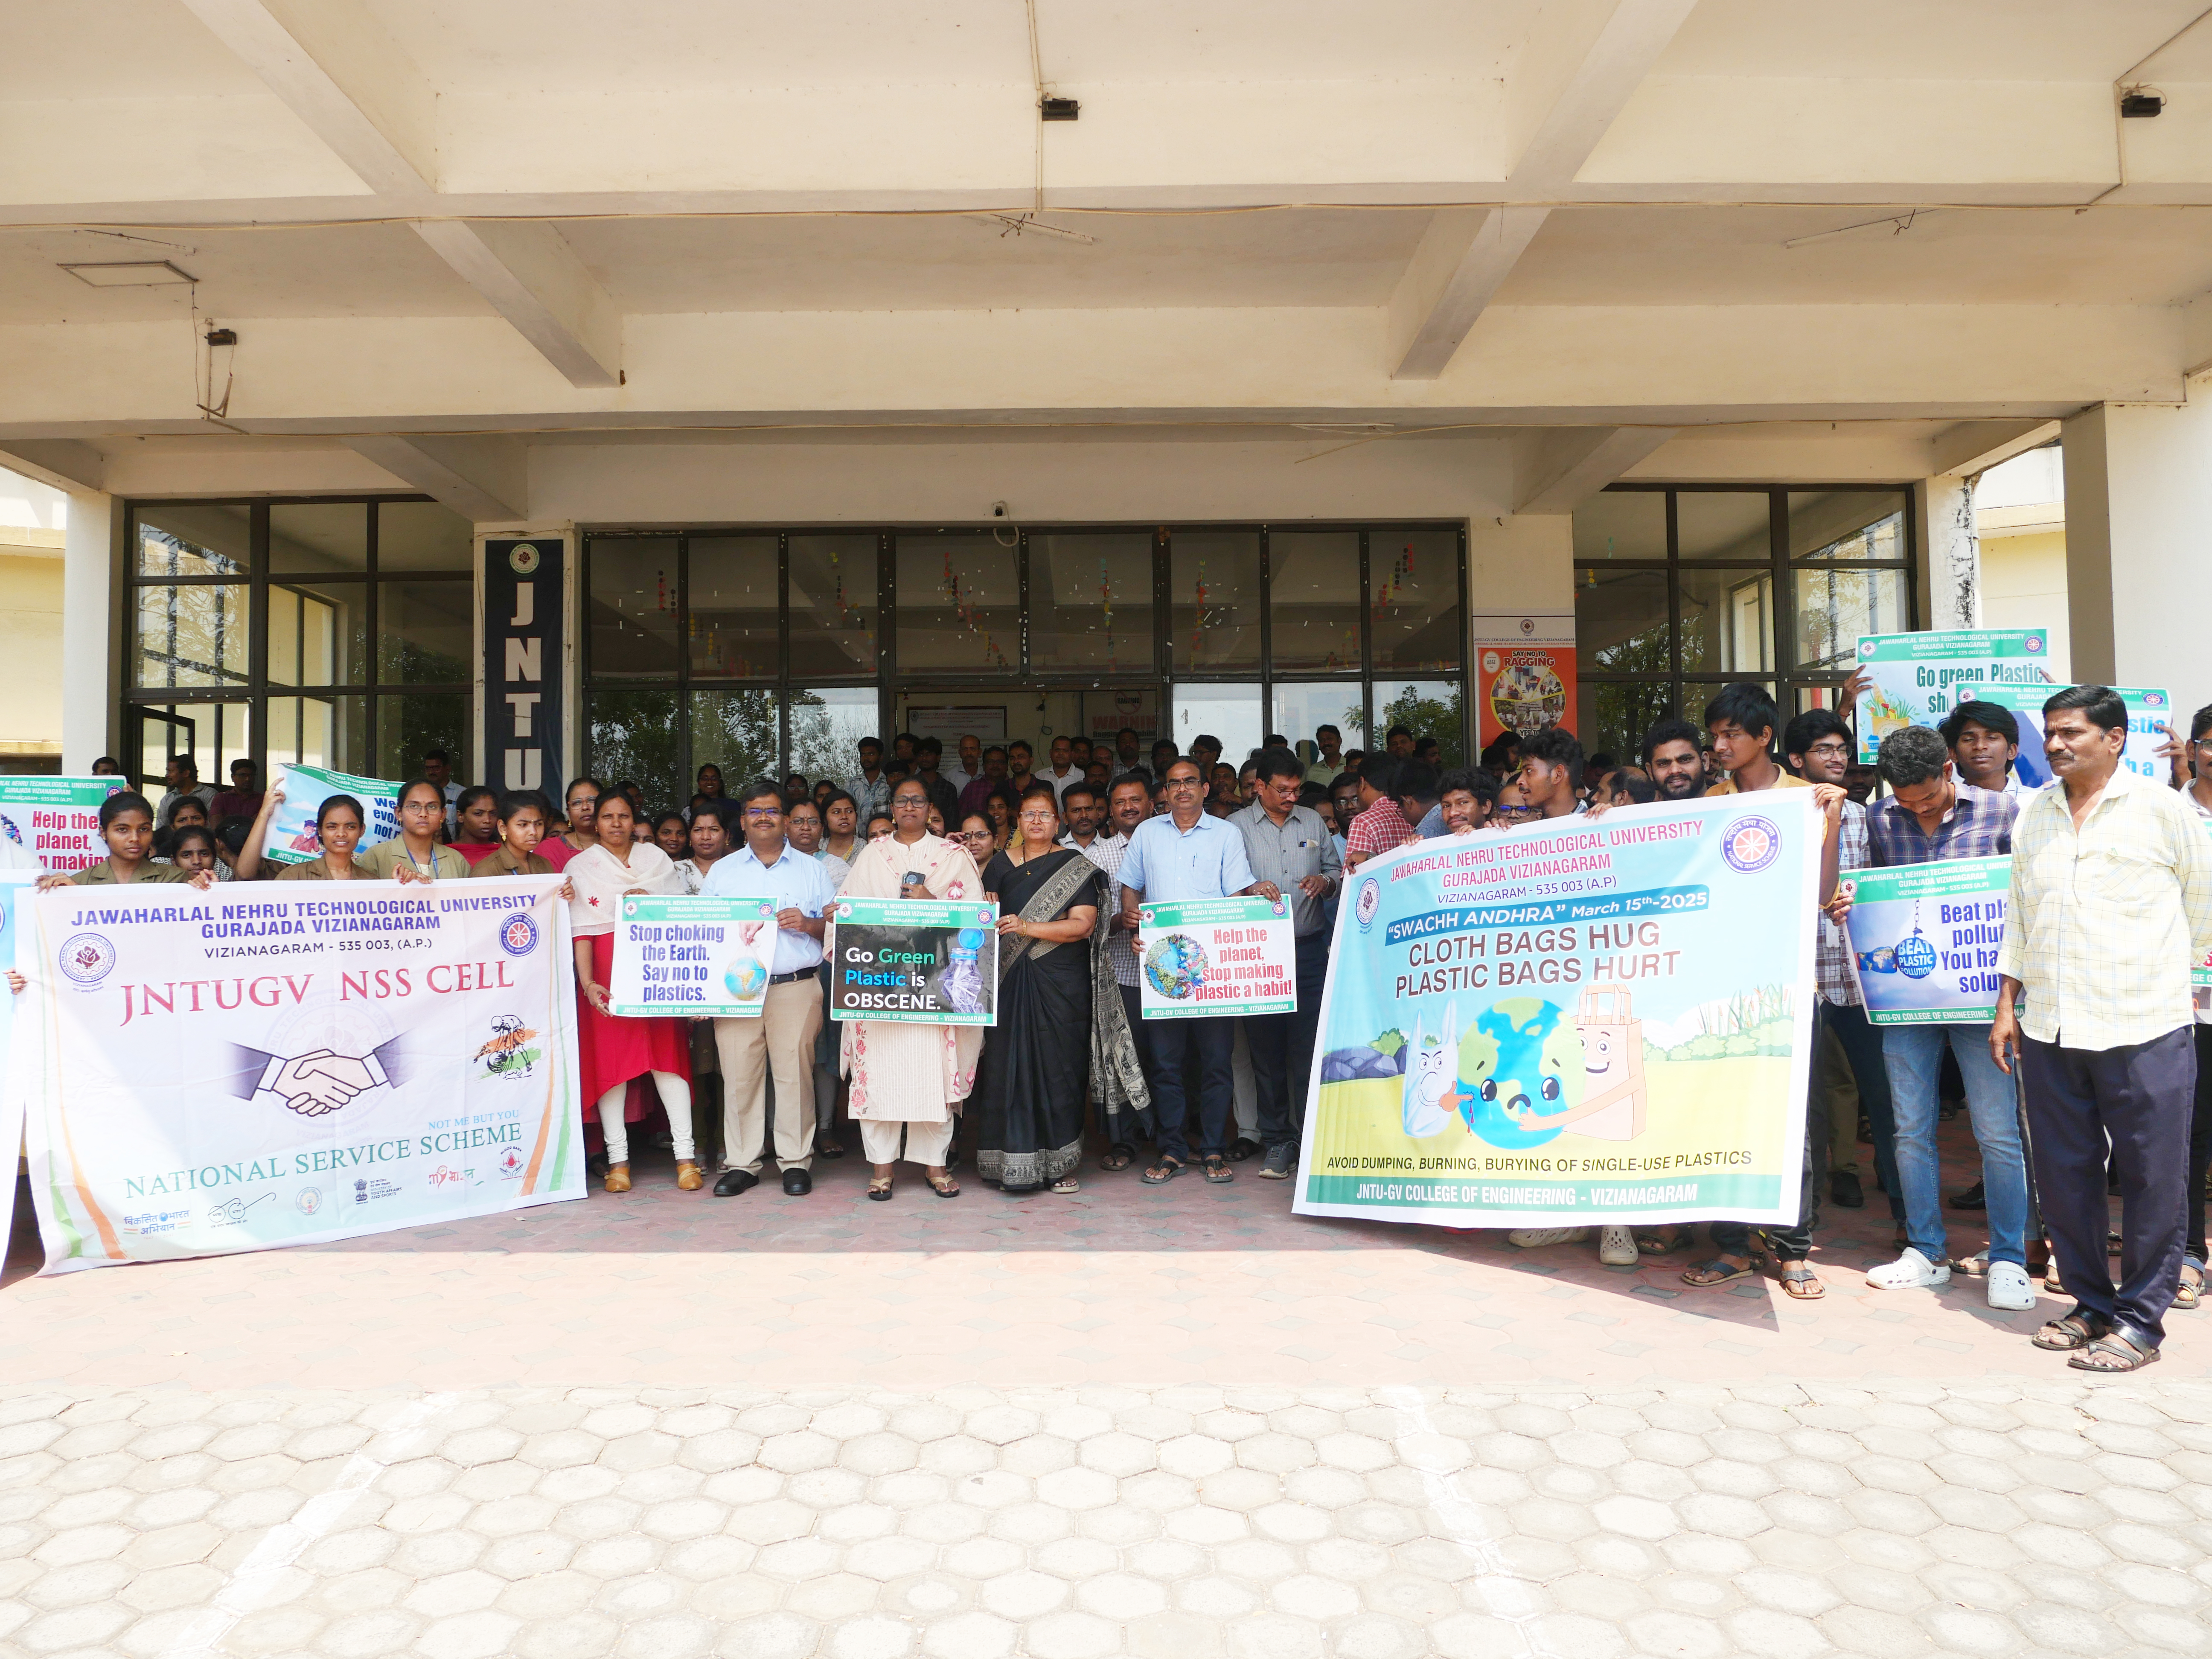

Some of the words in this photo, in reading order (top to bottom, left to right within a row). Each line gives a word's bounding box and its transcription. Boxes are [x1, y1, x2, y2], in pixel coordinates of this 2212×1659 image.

[1878, 637, 1918, 645] JAWAHARLAL
[1912, 642, 1944, 650] GURAJADA
[1946, 641, 1990, 649] VIZIANAGARAM
[1504, 658, 1555, 666] RAGGING
[1916, 666, 1936, 687] Go
[1939, 667, 1983, 689] green
[1991, 663, 2043, 683] Plastic
[504, 582, 542, 791] JNTU
[1928, 692, 1949, 713] sh
[326, 775, 351, 786] GURAJADA
[352, 782, 389, 791] VIZIANAGARAM
[347, 777, 386, 786] TECHNOLOGICAL
[32, 811, 67, 830] Help
[71, 813, 98, 830] the
[1759, 821, 1775, 837] योजना
[374, 824, 393, 839] not
[36, 832, 92, 851] planet,
[1391, 855, 1452, 882] JAWAHARLAL
[1457, 847, 1494, 867] NEHRU
[1498, 834, 1606, 861] TECHNOLOGICAL
[1610, 820, 1703, 845] UNIVERSITY
[276, 852, 303, 863] JNTU-GV
[1727, 850, 1744, 868] NATIONAL
[1743, 860, 1763, 869] SERVICE
[1761, 846, 1776, 863] SCHEME
[1443, 866, 1506, 888] GURAJADA
[1509, 853, 1611, 880] VIZIANAGARAM
[1438, 886, 1527, 904] VIZIANAGARAM
[1536, 882, 1558, 895] 535
[1561, 880, 1583, 893] 003
[1586, 875, 1617, 891] (A.P)
[71, 906, 214, 926] JAWAHARLAL
[222, 903, 288, 920] NEHRU
[295, 899, 435, 917] TECHNOLOGICAL
[441, 894, 537, 912] UNIVERSITY
[1571, 901, 1619, 918] March
[1625, 892, 1707, 911] 15th-2025
[1941, 902, 1980, 924] Beat
[202, 921, 306, 938] GURAJADA
[314, 916, 441, 933] VIZIANAGARAM
[630, 924, 662, 943] Stop
[666, 924, 725, 943] choking
[1213, 928, 1243, 945] Help
[1246, 927, 1267, 942] the
[204, 942, 323, 959] VIZIANAGARAM
[339, 941, 363, 951] 535
[366, 940, 393, 951] 003,
[397, 939, 432, 950] (A.P.)
[642, 944, 665, 961] the
[669, 944, 710, 961] Earth.
[1409, 934, 1487, 967] CLOTH
[1495, 927, 1577, 956] BAGS
[1589, 921, 1660, 950] HUG
[1898, 938, 1931, 955] BEAT
[846, 947, 873, 963] Go
[878, 948, 934, 964] Green
[1220, 946, 1264, 963] planet,
[1898, 955, 1933, 967] PLASTIC
[1941, 950, 1972, 971] You
[643, 964, 669, 983] Say
[672, 967, 690, 981] no
[694, 965, 708, 981] to
[845, 970, 907, 986] Plastic
[912, 972, 925, 987] is
[1202, 966, 1231, 982] stop
[1234, 963, 1283, 979] making
[1396, 963, 1489, 999] PLASTIC
[1498, 958, 1582, 986] BAGS
[1593, 950, 1681, 981] HURT
[1900, 966, 1933, 976] POLLUTION
[120, 974, 314, 1027] JNTUGV
[340, 968, 412, 1001] NSS
[426, 961, 514, 993] CELL
[643, 984, 706, 1003] plastics.
[1196, 984, 1240, 1001] plastic
[1244, 986, 1252, 997] a
[1254, 980, 1292, 997] habit!
[844, 992, 941, 1010] OBSCENE.
[1876, 1013, 1901, 1022] JNTU-GV
[1902, 1012, 1931, 1021] COLLEGE
[1933, 1011, 1941, 1019] OF
[1943, 1010, 1988, 1020] ENGINEERING
[428, 1119, 451, 1130] NOT
[454, 1116, 470, 1127] ME
[473, 1113, 494, 1124] BUT
[497, 1109, 520, 1121] YOU
[501, 1146, 512, 1155] BLOOD
[124, 1157, 286, 1198] NATIONAL
[296, 1140, 411, 1174] SERVICE
[420, 1123, 522, 1156] SCHEME
[1327, 1157, 1359, 1169] AVOID
[1362, 1157, 1415, 1171] DUMPING,
[1419, 1157, 1480, 1172] BURNING,
[1485, 1158, 1551, 1172] BURYING
[1557, 1159, 1578, 1172] OF
[1582, 1156, 1671, 1171] SINGLE-USE
[1675, 1151, 1752, 1168] PLASTICS
[1356, 1183, 1403, 1201] JNTU-GV
[1406, 1185, 1458, 1202] COLLEGE
[1461, 1186, 1478, 1203] OF
[1485, 1186, 1576, 1206] ENGINEERING
[1591, 1184, 1698, 1205] VIZIANAGARAM
[123, 1213, 158, 1225] विकसित
[168, 1210, 190, 1220] भारत
[140, 1223, 175, 1234] अभियान
